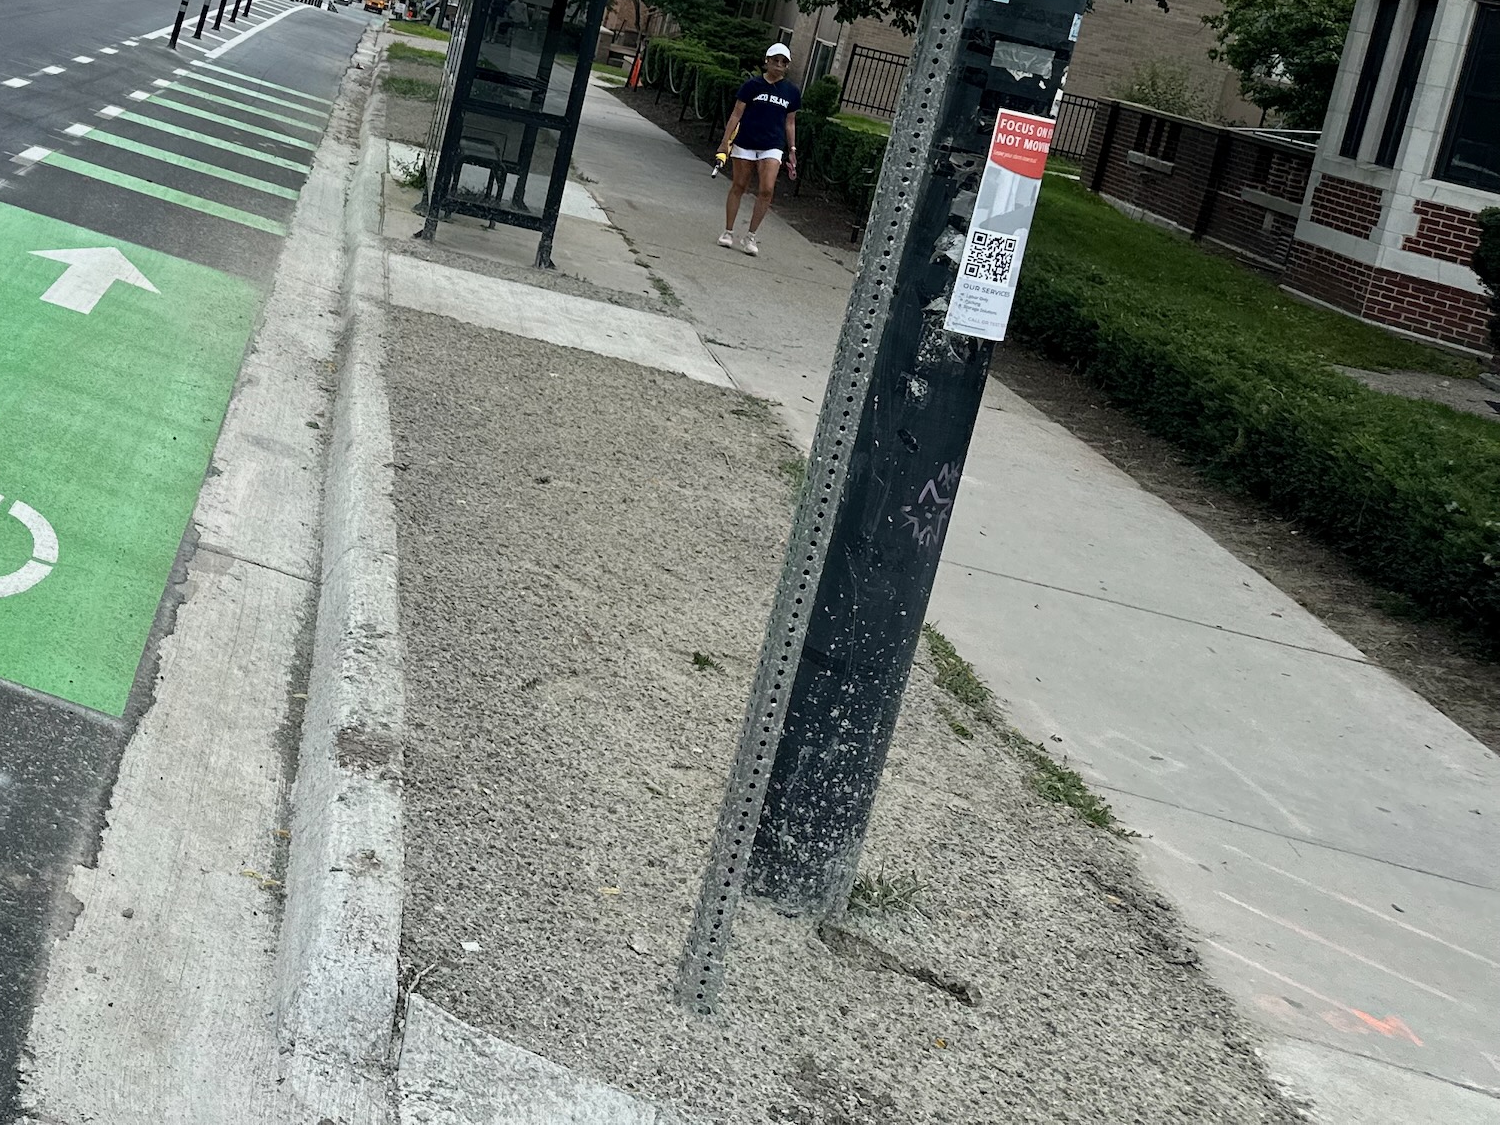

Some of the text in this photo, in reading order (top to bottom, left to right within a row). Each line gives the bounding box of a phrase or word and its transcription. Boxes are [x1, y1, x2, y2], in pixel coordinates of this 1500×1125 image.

[1000, 118, 1035, 136] FOCUS
[996, 133, 1022, 148] NOT
[963, 282, 981, 292] OUR
